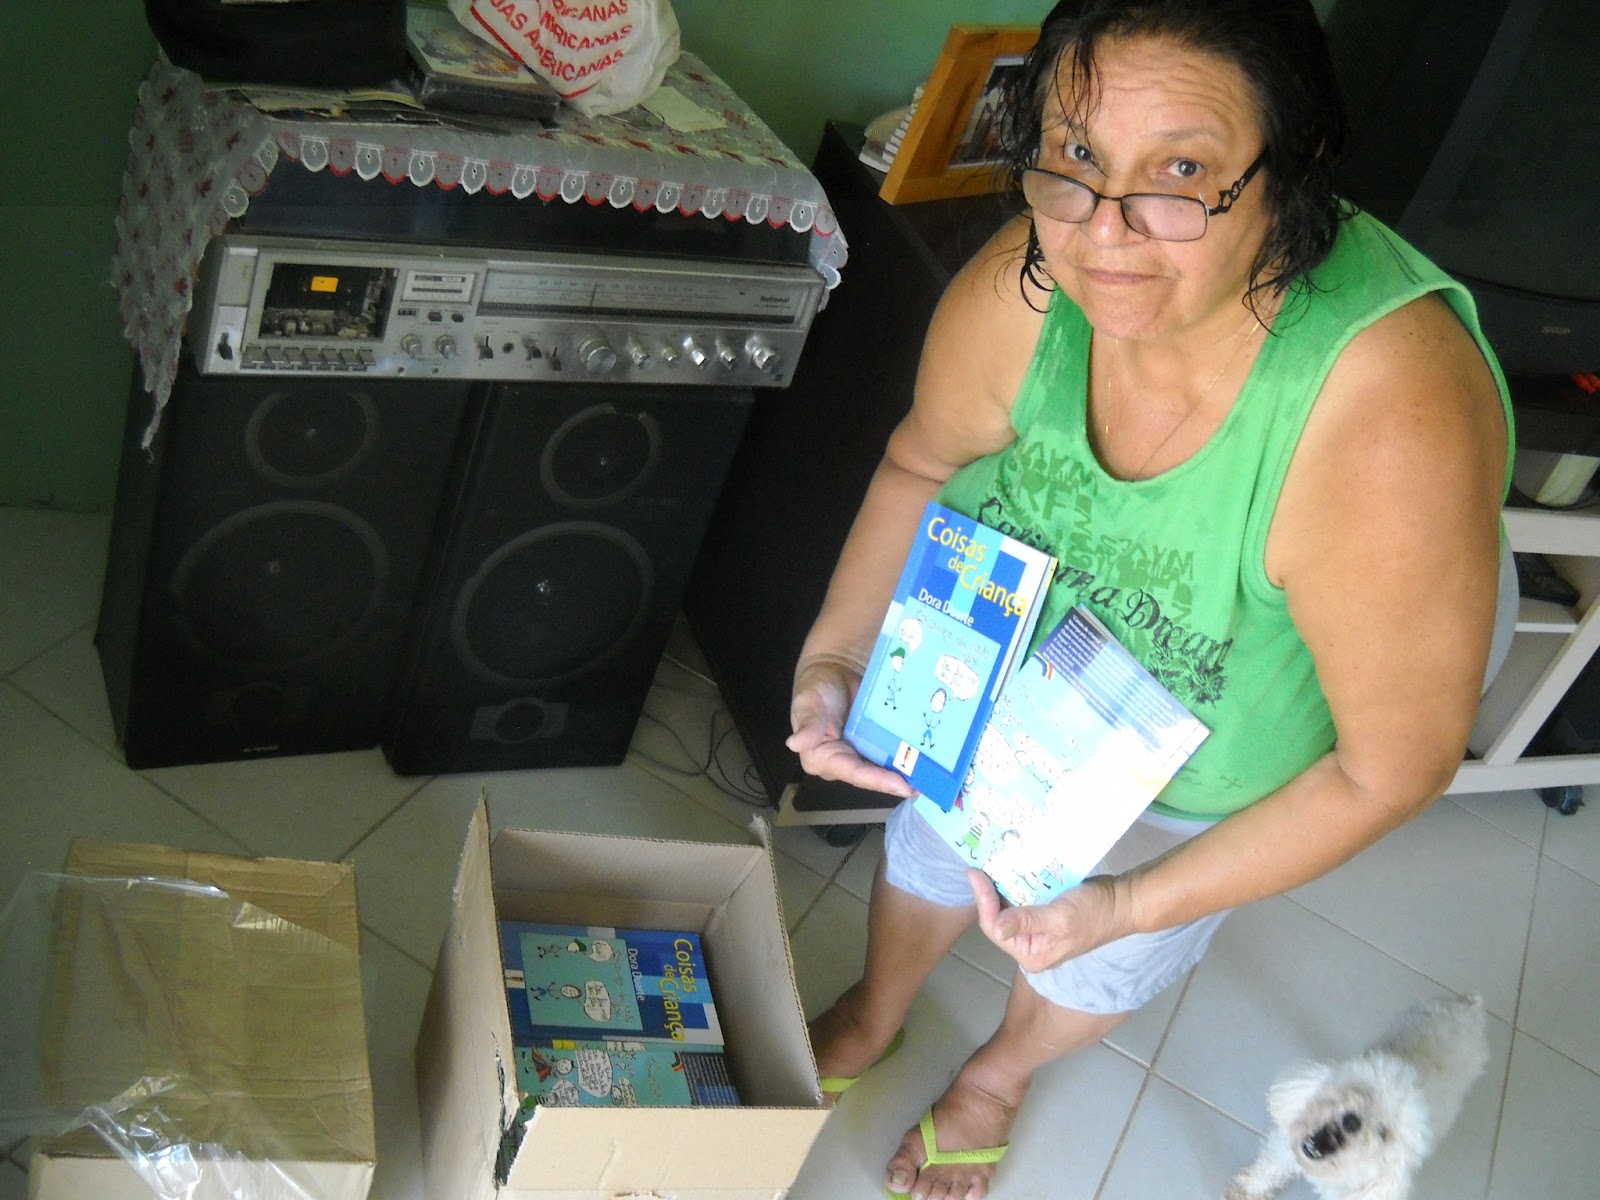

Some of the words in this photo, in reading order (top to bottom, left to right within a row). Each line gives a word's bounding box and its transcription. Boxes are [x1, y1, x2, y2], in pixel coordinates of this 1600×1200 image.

[927, 517, 987, 562] Coisas
[918, 588, 942, 609] Dora
[948, 555, 965, 573] de
[960, 564, 1028, 618] Criança
[628, 948, 639, 970] Dora
[664, 964, 676, 981] de
[674, 938, 697, 993] Coisas
[632, 971, 646, 1001] Duarte
[659, 978, 688, 1042] Criança
